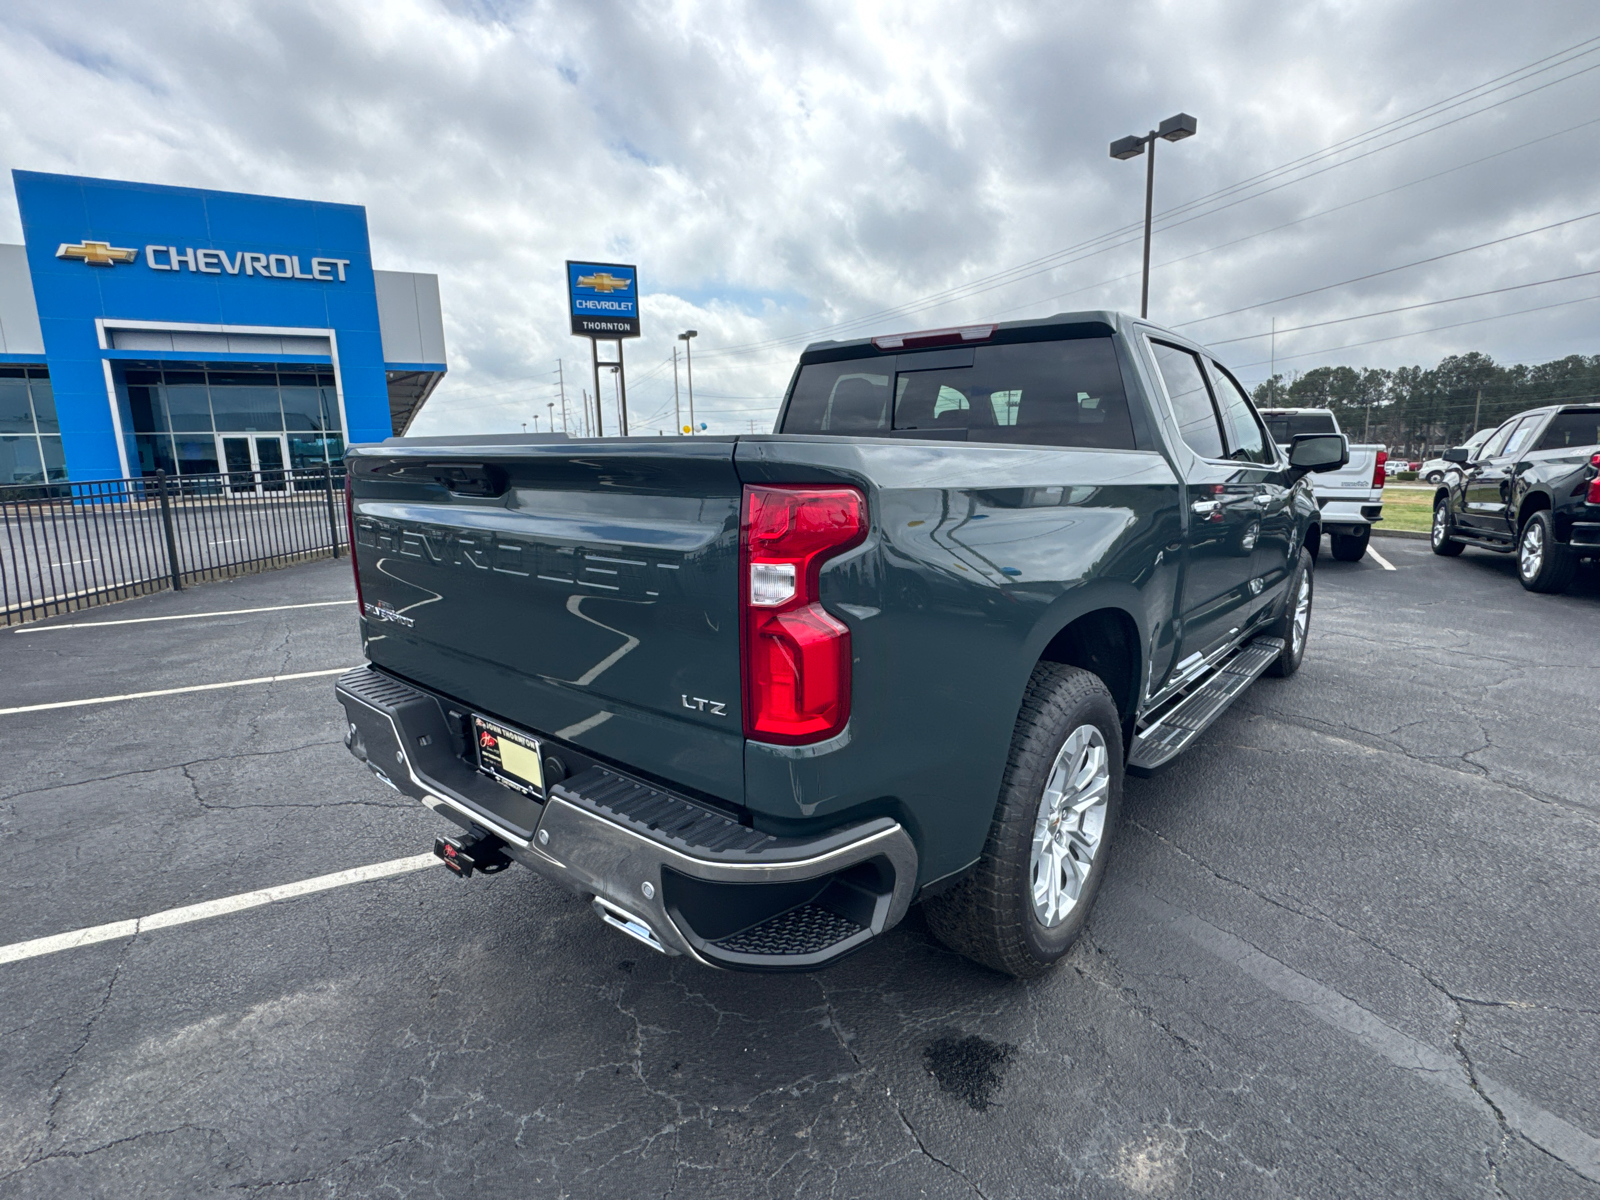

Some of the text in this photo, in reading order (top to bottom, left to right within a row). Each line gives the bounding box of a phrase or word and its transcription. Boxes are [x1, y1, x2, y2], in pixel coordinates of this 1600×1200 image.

[145, 244, 350, 282] CHEVROLET
[575, 299, 633, 311] CHEVROLET
[582, 321, 631, 331] THORNTON
[681, 694, 727, 716] LTZ
